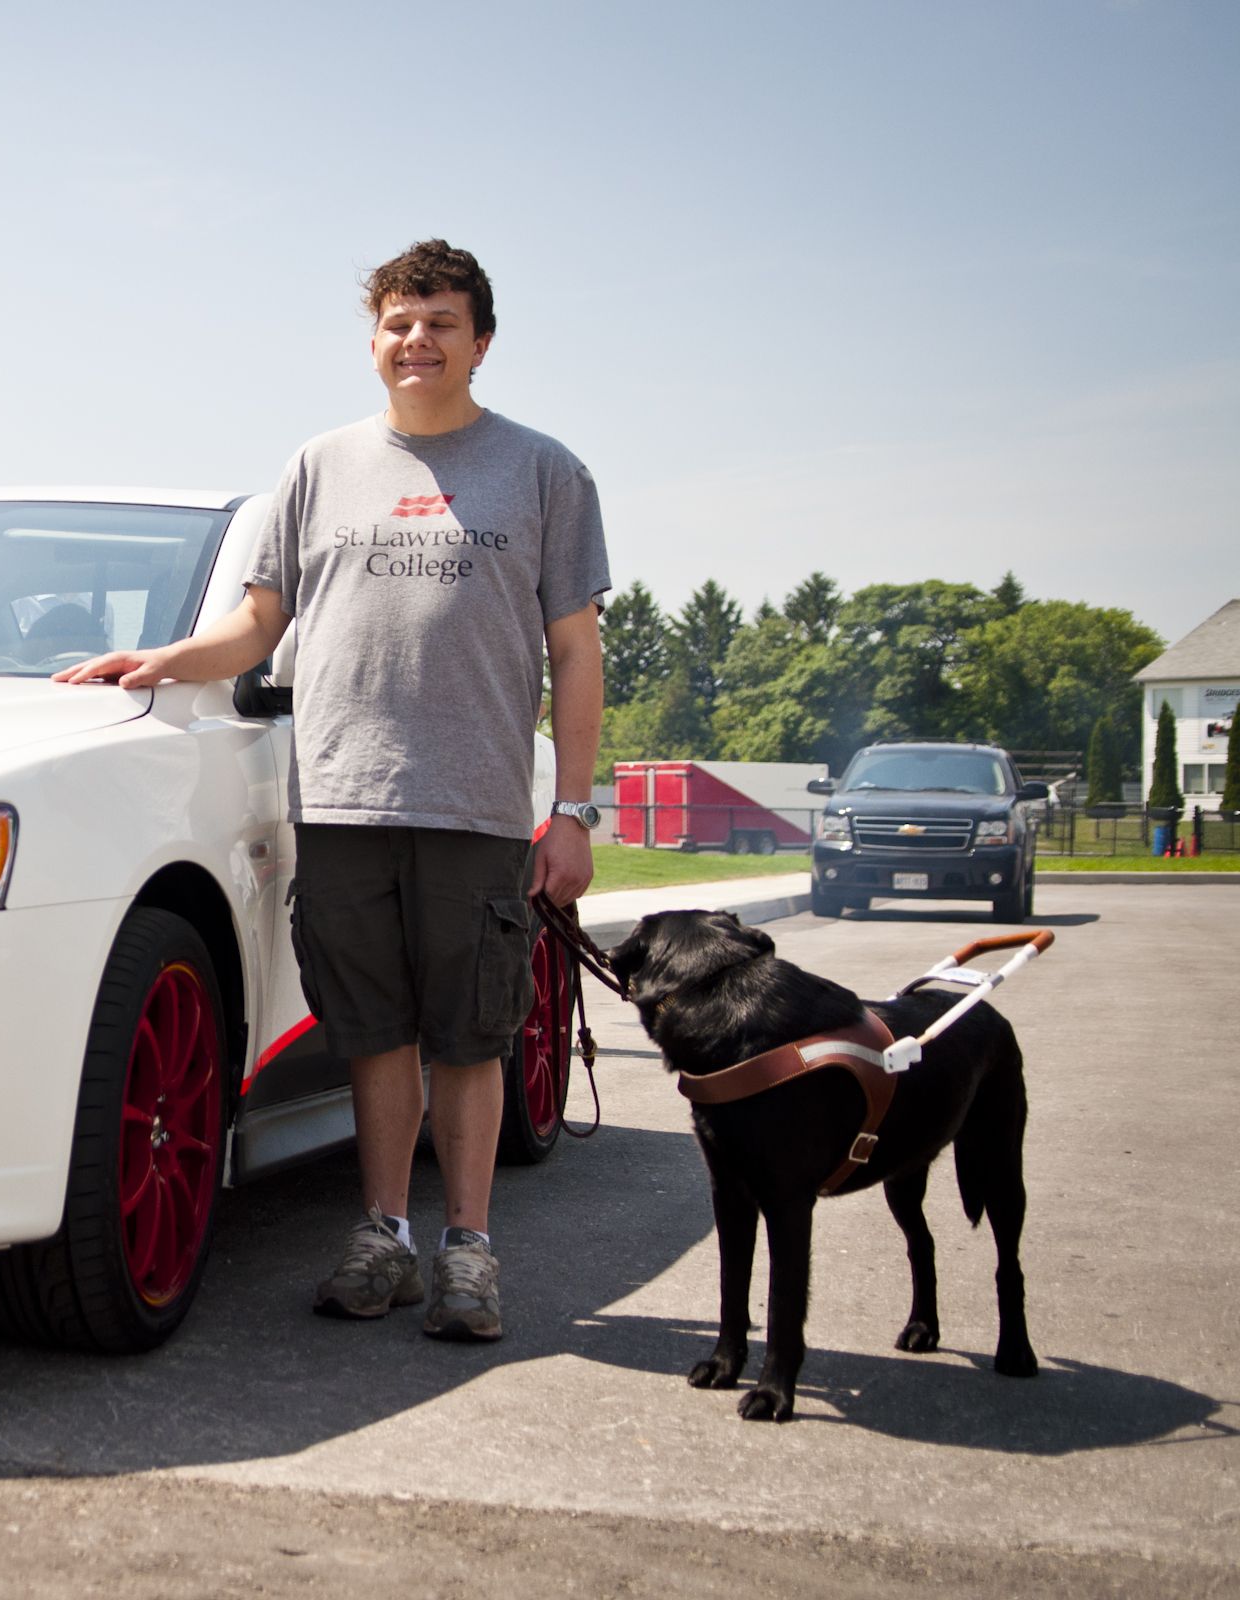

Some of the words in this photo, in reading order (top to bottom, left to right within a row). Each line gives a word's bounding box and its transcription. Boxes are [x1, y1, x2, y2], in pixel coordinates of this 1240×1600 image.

[334, 525, 364, 549] St.
[371, 524, 509, 551] Lawrence
[366, 552, 473, 585] College
